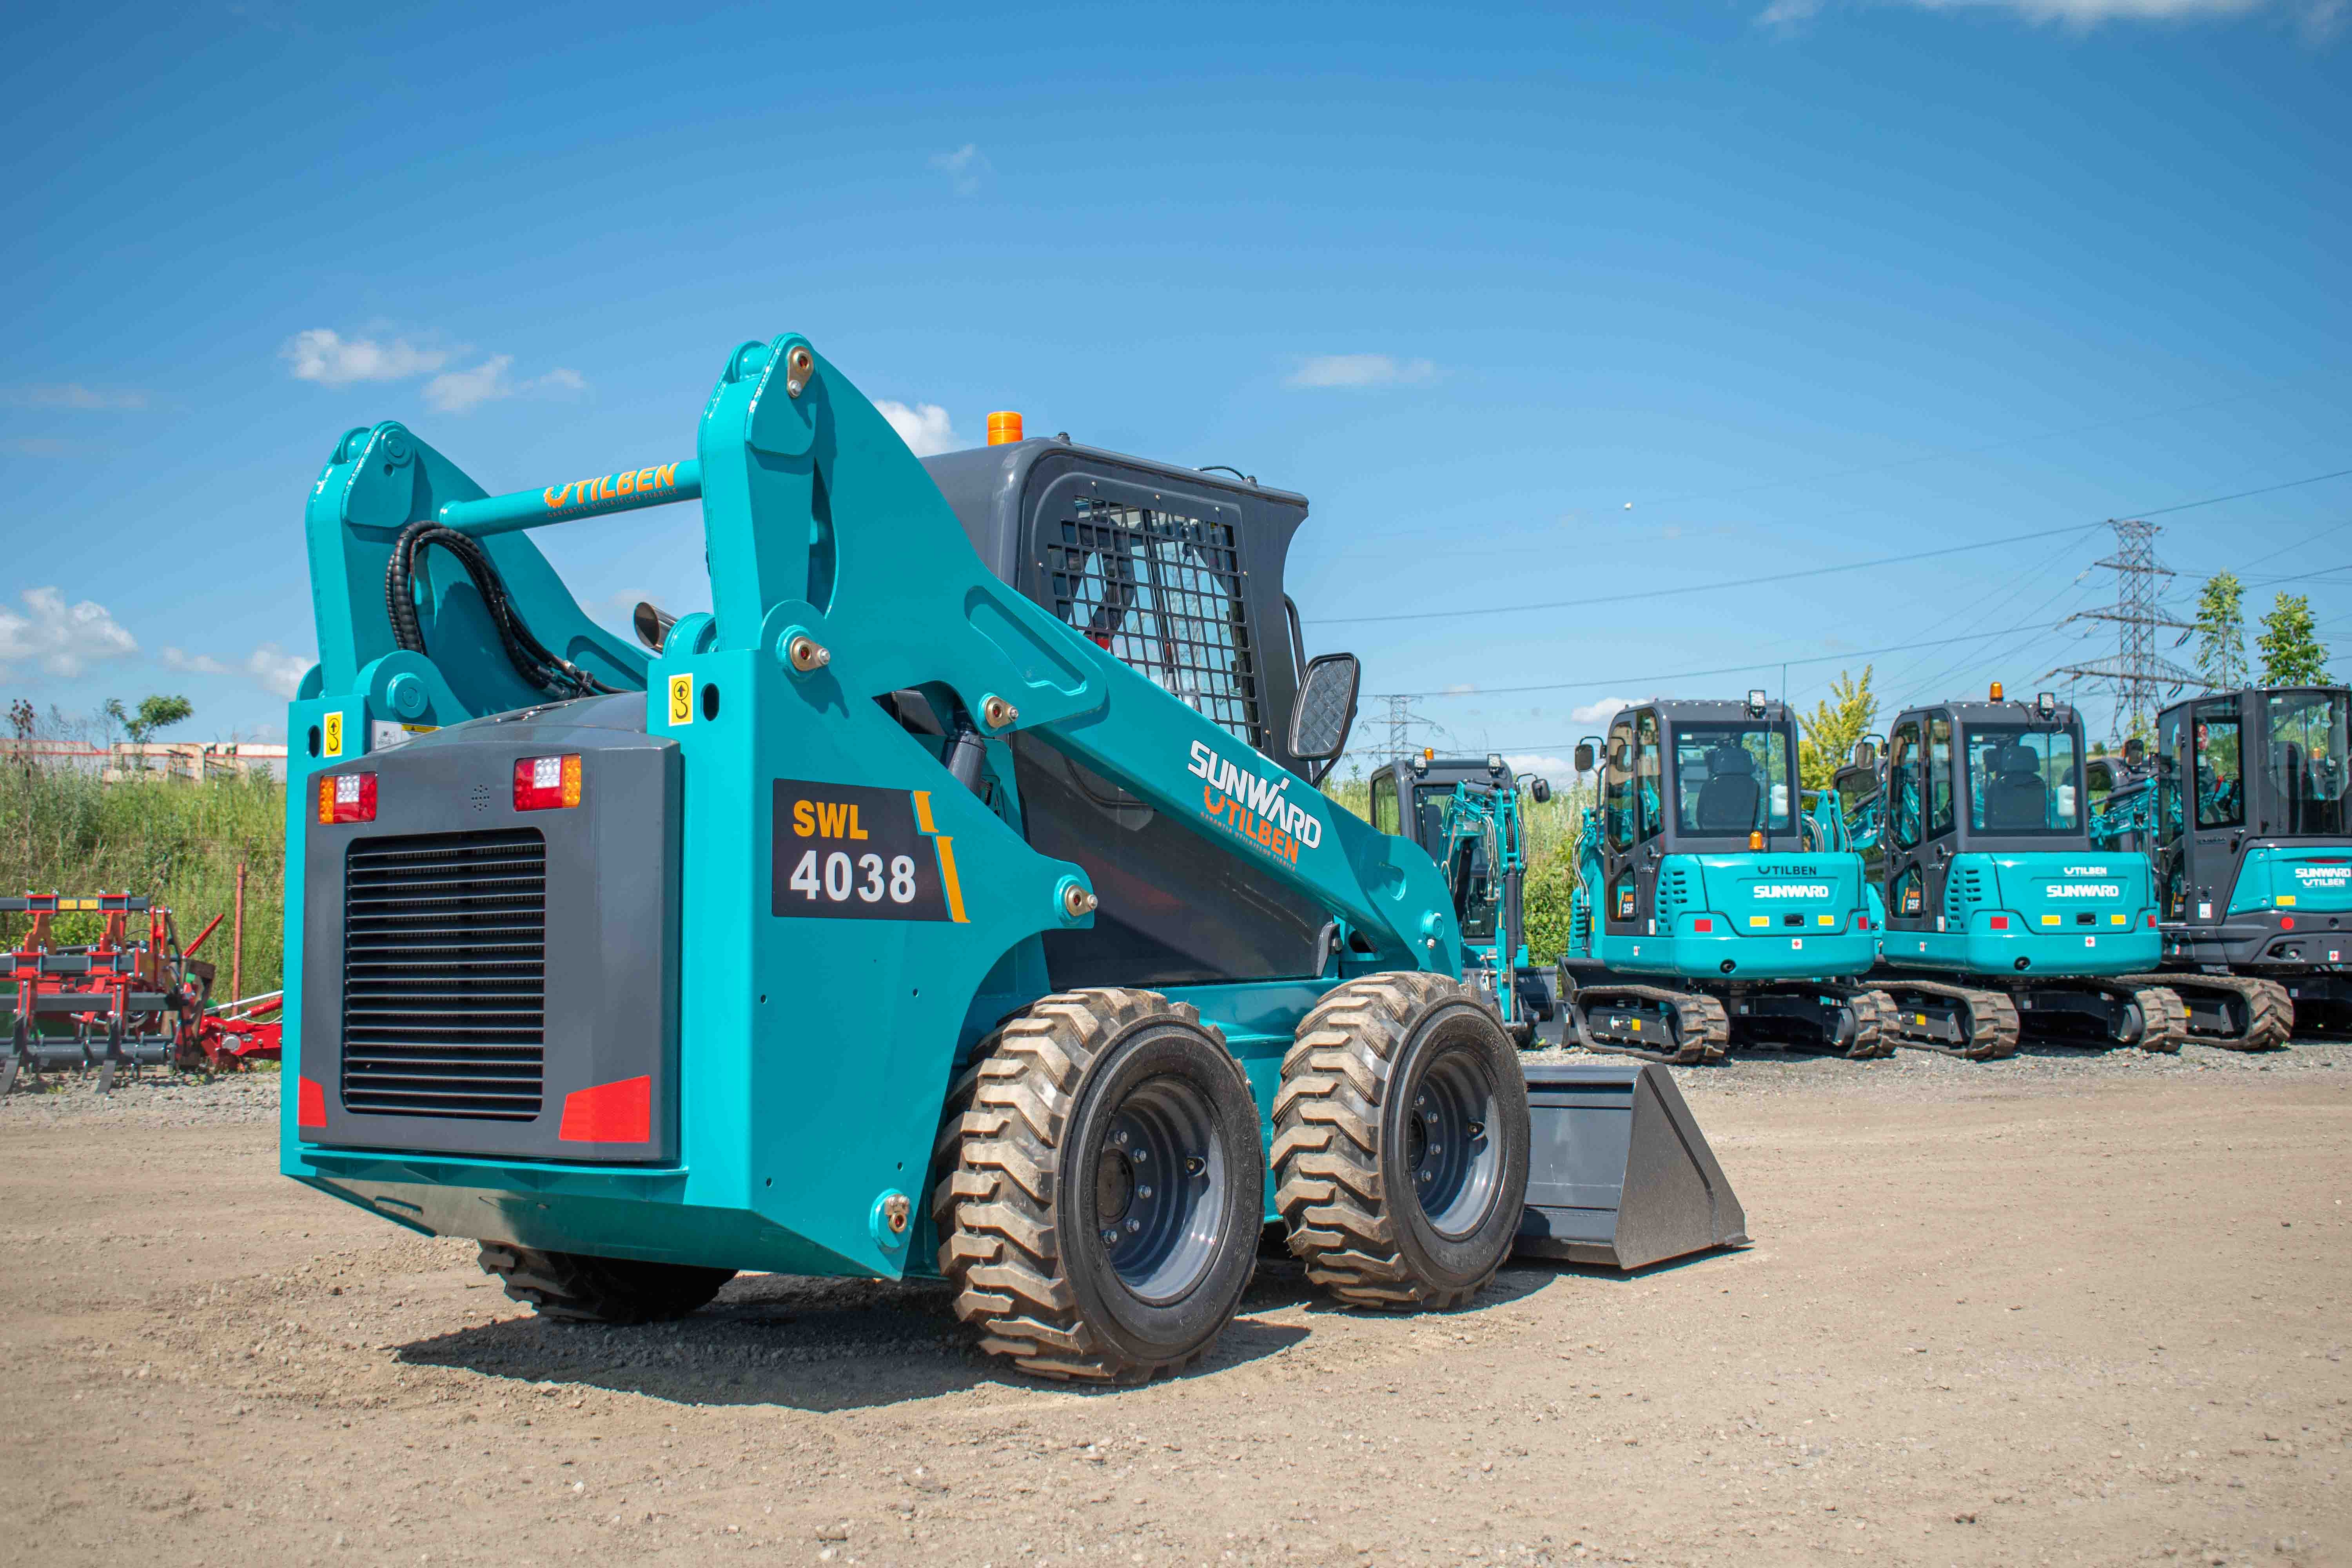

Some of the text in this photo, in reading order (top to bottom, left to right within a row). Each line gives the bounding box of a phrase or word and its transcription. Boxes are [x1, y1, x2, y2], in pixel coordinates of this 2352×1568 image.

[543, 462, 680, 508] UTILBEN
[1187, 739, 1321, 849] SUNWARD
[793, 800, 868, 840] SWL
[1203, 785, 1299, 864] UTILBEN
[790, 850, 916, 903] 4038
[1757, 865, 1817, 875] UTILBEN
[2063, 866, 2107, 875] UTILBEN
[2295, 867, 2352, 878] SUNWARD
[2302, 878, 2346, 886] UTILBEN
[1753, 885, 1829, 898] SUNWARD
[2046, 884, 2119, 898] SUNWARD
